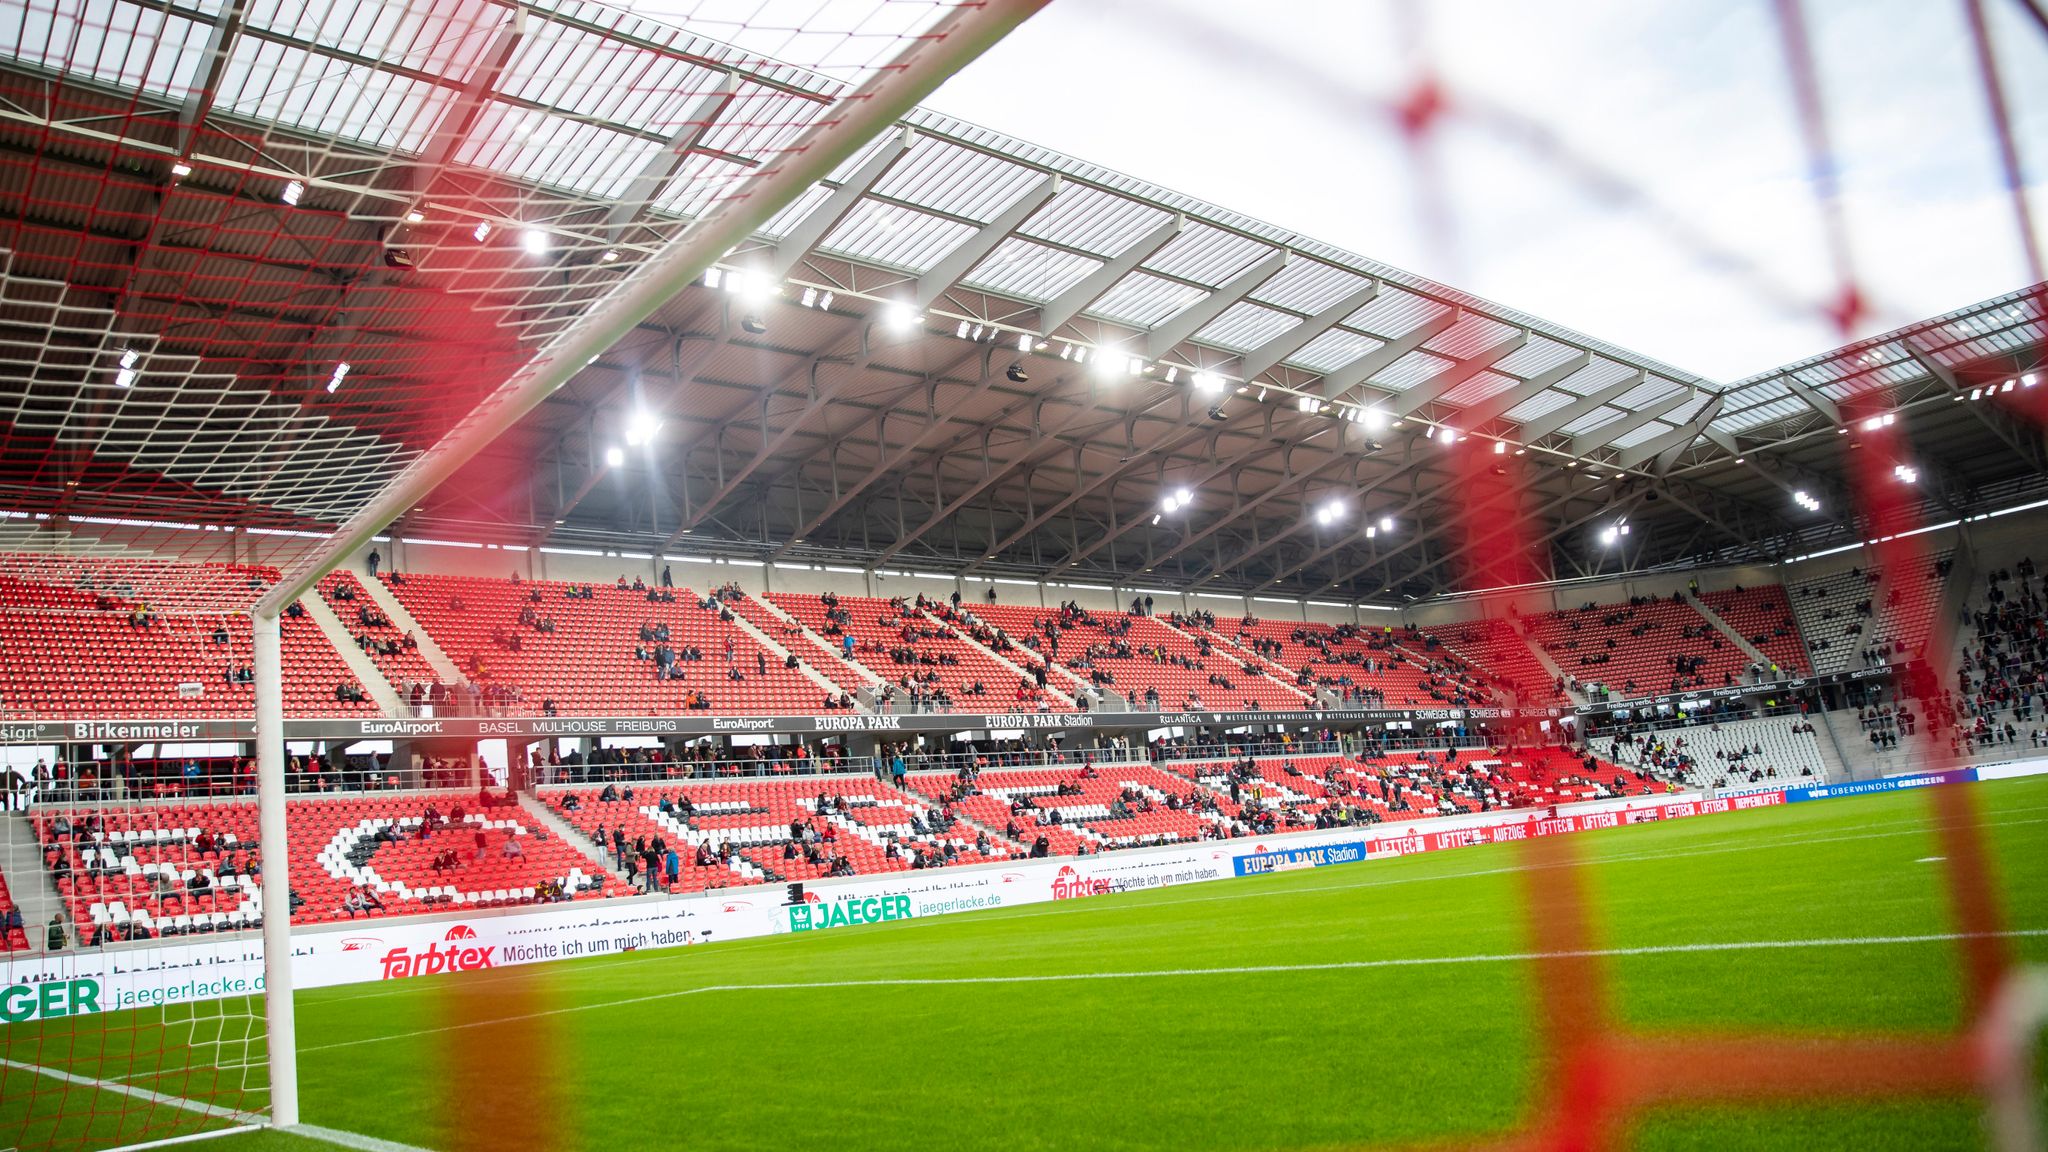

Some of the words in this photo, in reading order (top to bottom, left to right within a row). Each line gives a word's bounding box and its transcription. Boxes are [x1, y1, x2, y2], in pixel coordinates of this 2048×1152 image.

[1713, 688, 1741, 697] Freiburg
[1741, 684, 1777, 693] verbunden
[1470, 709, 1500, 719] SCHWEIGER
[1607, 702, 1634, 710] Freiburg
[815, 716, 863, 730] EUROPA
[868, 716, 900, 729] PARK
[985, 715, 1029, 728] EUROPA
[1034, 714, 1062, 727] PARK
[1064, 714, 1093, 727] Stadion
[1416, 710, 1449, 720] SCHWEIGER
[74, 723, 200, 739] Birkenmeier
[361, 721, 443, 734] EuroAirport
[479, 722, 523, 733] BASEL
[532, 721, 607, 733] MULHOUSE
[616, 720, 677, 732] FREIBURG
[713, 718, 774, 731] EuroAirport
[1831, 781, 1895, 796] ÜBERWINDEN
[1897, 775, 1945, 788] GRENZEN
[1536, 818, 1568, 836] LIFTTEC
[1582, 813, 1611, 830] LIFTTEC
[1436, 830, 1473, 849] LIFTTEC
[1493, 825, 1527, 842] AUFZÜGE
[1243, 852, 1290, 874] EUROPA
[1328, 845, 1359, 864] Stadion
[1147, 873, 1160, 886] ich
[1175, 870, 1194, 882] mich
[1194, 868, 1220, 880] haben.
[814, 894, 913, 929] JAEGER
[919, 893, 1002, 917] jaegerlacke.de
[380, 942, 496, 980] farbtex
[503, 942, 558, 962] Möchte
[562, 938, 583, 956] ich
[588, 939, 610, 953] um
[614, 933, 646, 950] mich
[0, 978, 102, 1023] GER
